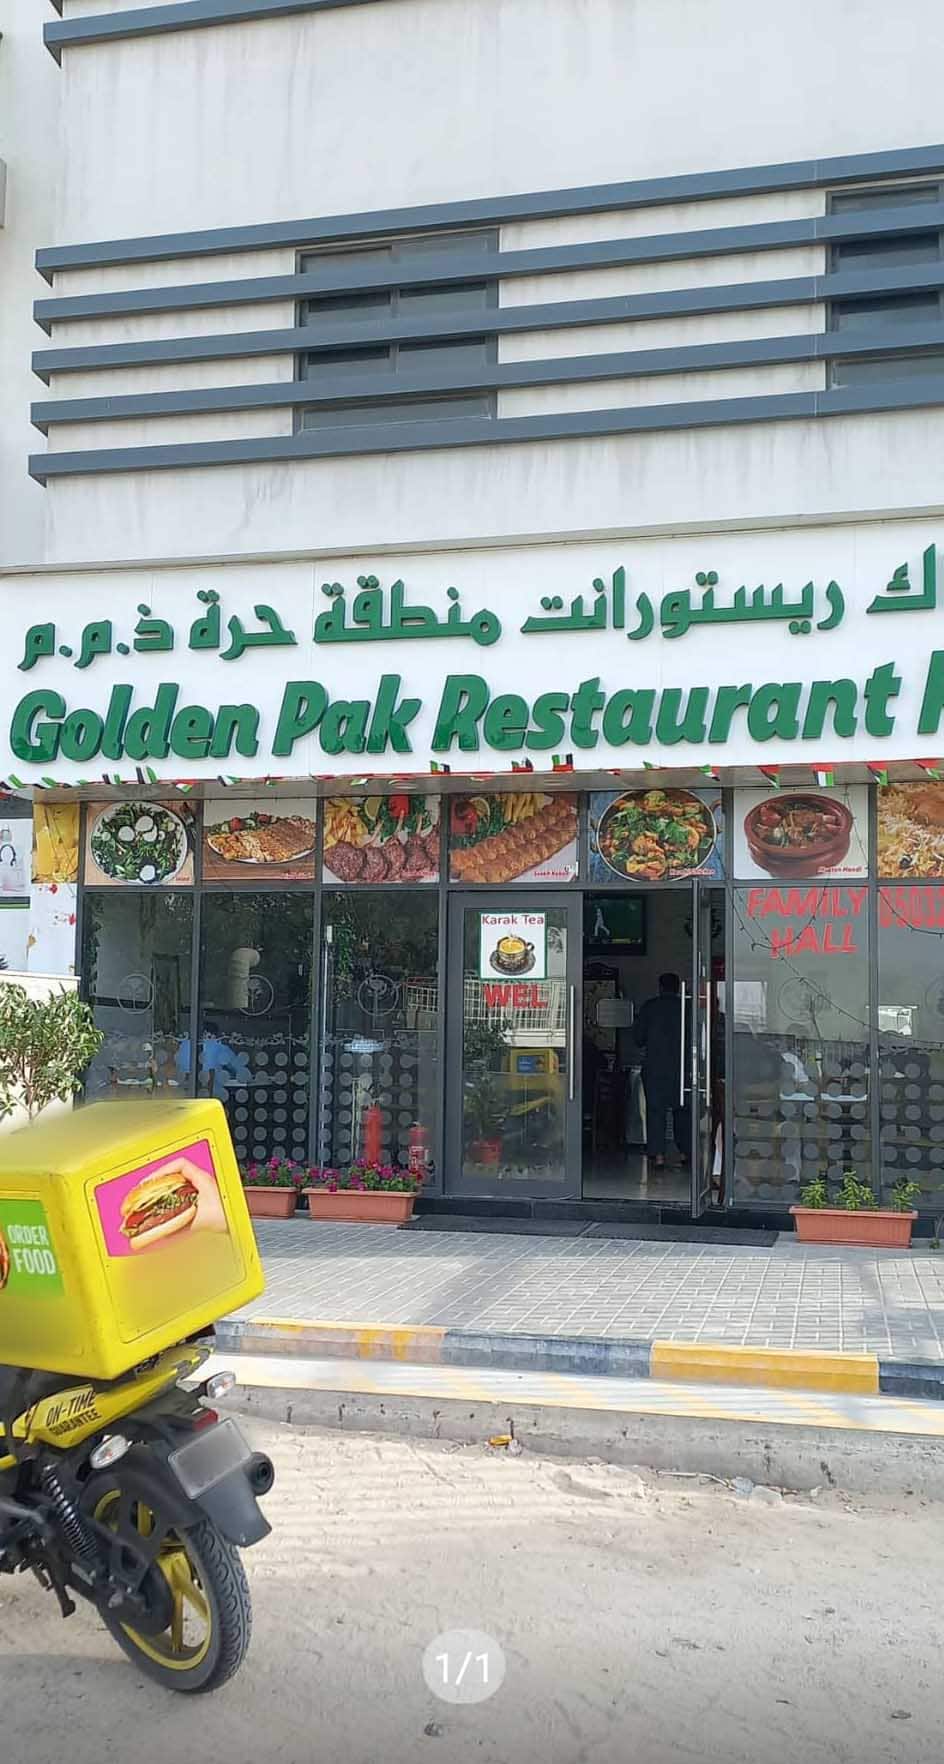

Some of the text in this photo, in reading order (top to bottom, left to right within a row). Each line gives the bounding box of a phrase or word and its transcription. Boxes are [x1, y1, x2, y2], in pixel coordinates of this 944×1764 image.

[313, 575, 502, 646] منطقة
[520, 566, 846, 641] ريستورانت
[17, 603, 174, 671] ذ.م.م
[188, 589, 298, 661] حرة
[10, 683, 260, 764] Golden
[271, 674, 422, 757] Pak
[431, 661, 902, 752] Restaurant
[482, 914, 544, 925] Karak Tea
[746, 887, 867, 920] FAMILY
[770, 922, 859, 960] HALL
[483, 982, 549, 1009] WEL
[7, 1225, 50, 1246] ORDER
[13, 1248, 57, 1275] FOOD
[46, 1391, 96, 1428] ON-TIME
[49, 1408, 102, 1436] GUARANTEE
